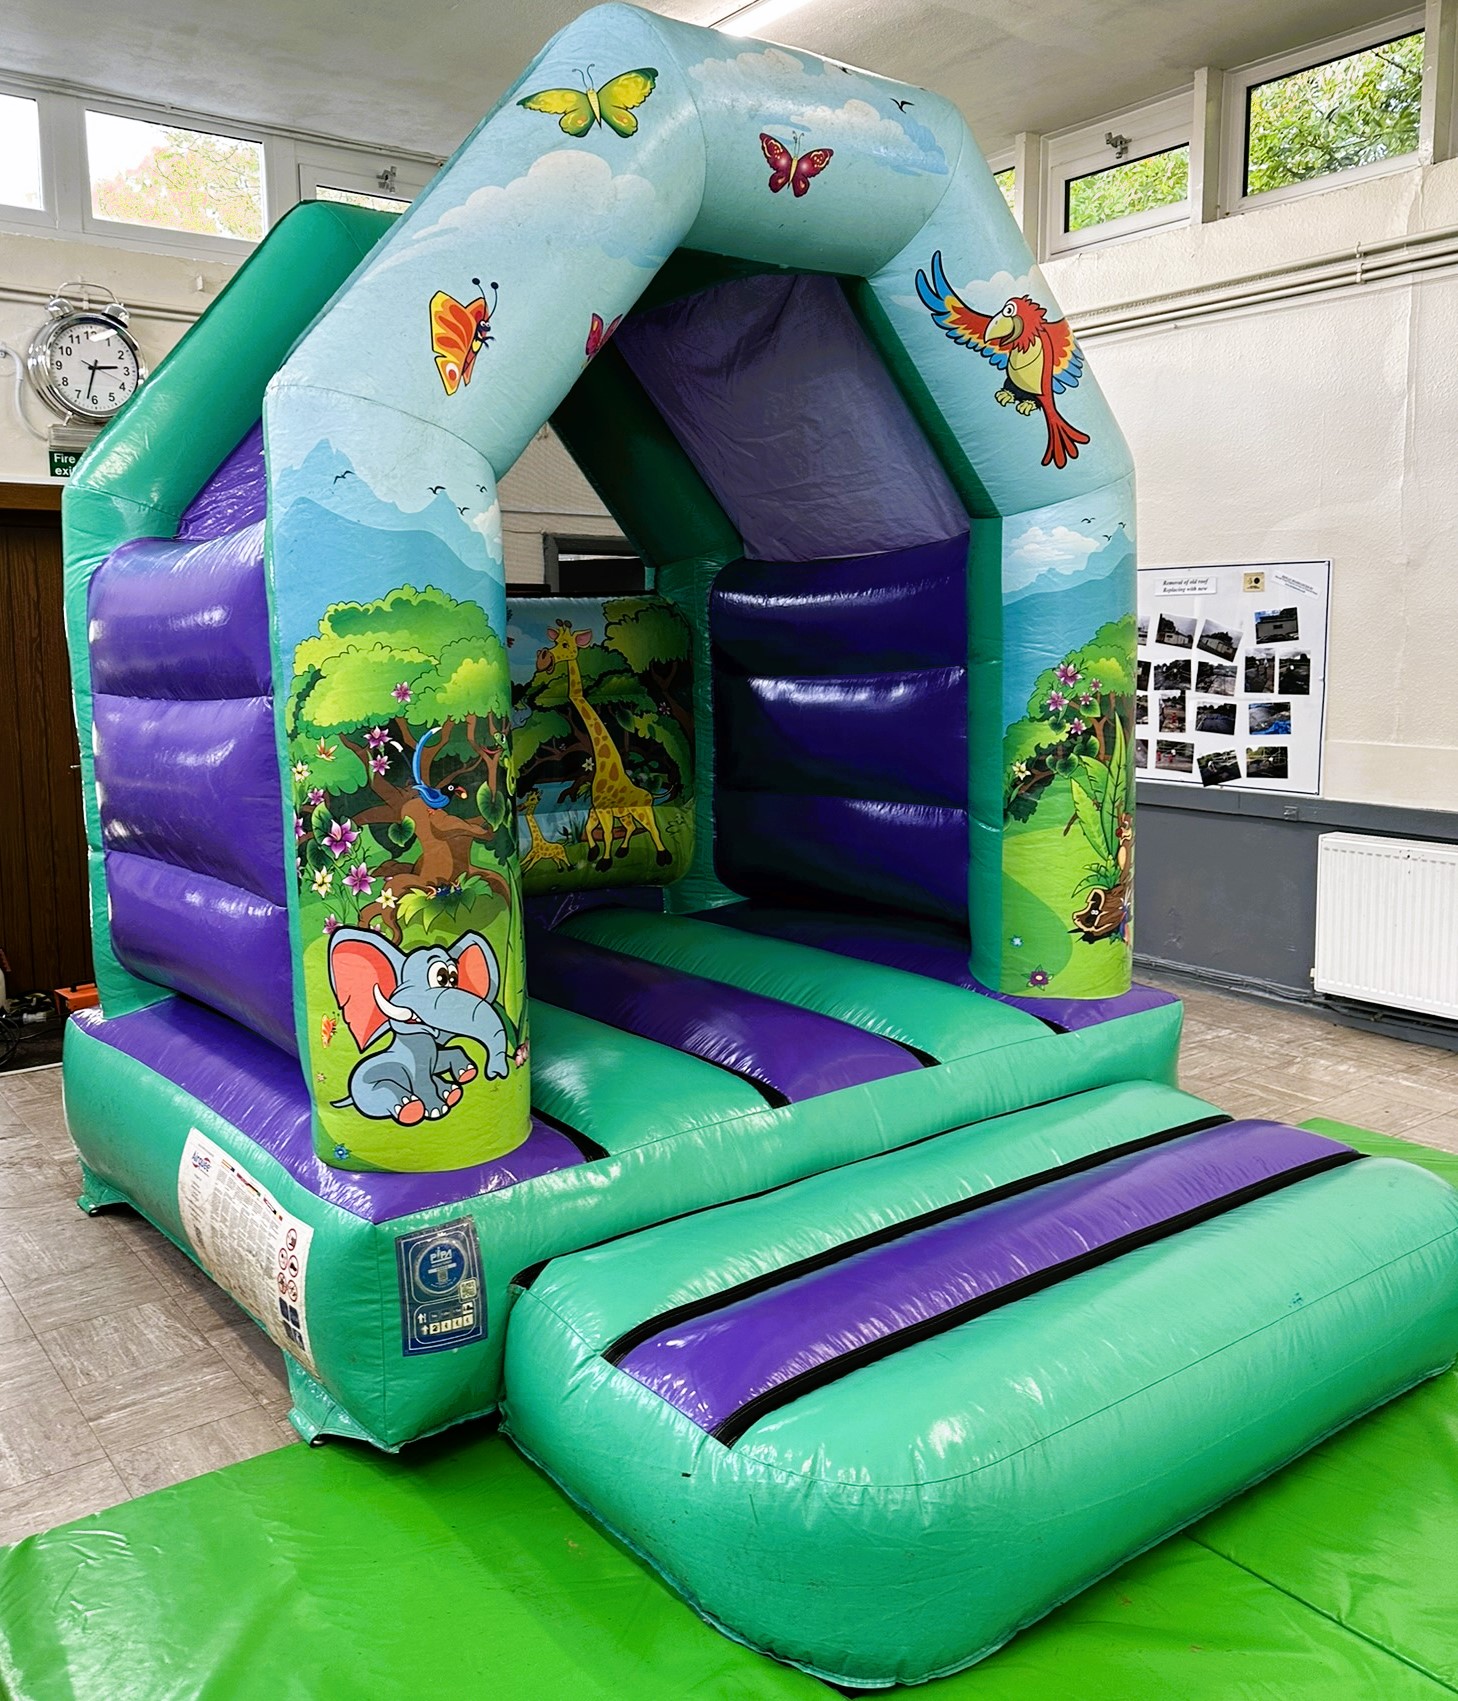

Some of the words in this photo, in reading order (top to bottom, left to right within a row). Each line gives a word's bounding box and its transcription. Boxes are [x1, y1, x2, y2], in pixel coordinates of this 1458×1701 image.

[68, 334, 81, 344] 11
[58, 345, 73, 356] 10
[117, 350, 125, 360] 2
[55, 360, 63, 370] 9
[123, 366, 130, 376] 3
[61, 376, 69, 386] 8
[118, 382, 126, 391] 4
[74, 389, 82, 399] 7
[108, 392, 116, 402] 5
[91, 395, 98, 405] 6
[53, 452, 76, 464] Fire
[54, 465, 74, 476] exi
[1197, 577, 1209, 585] roof
